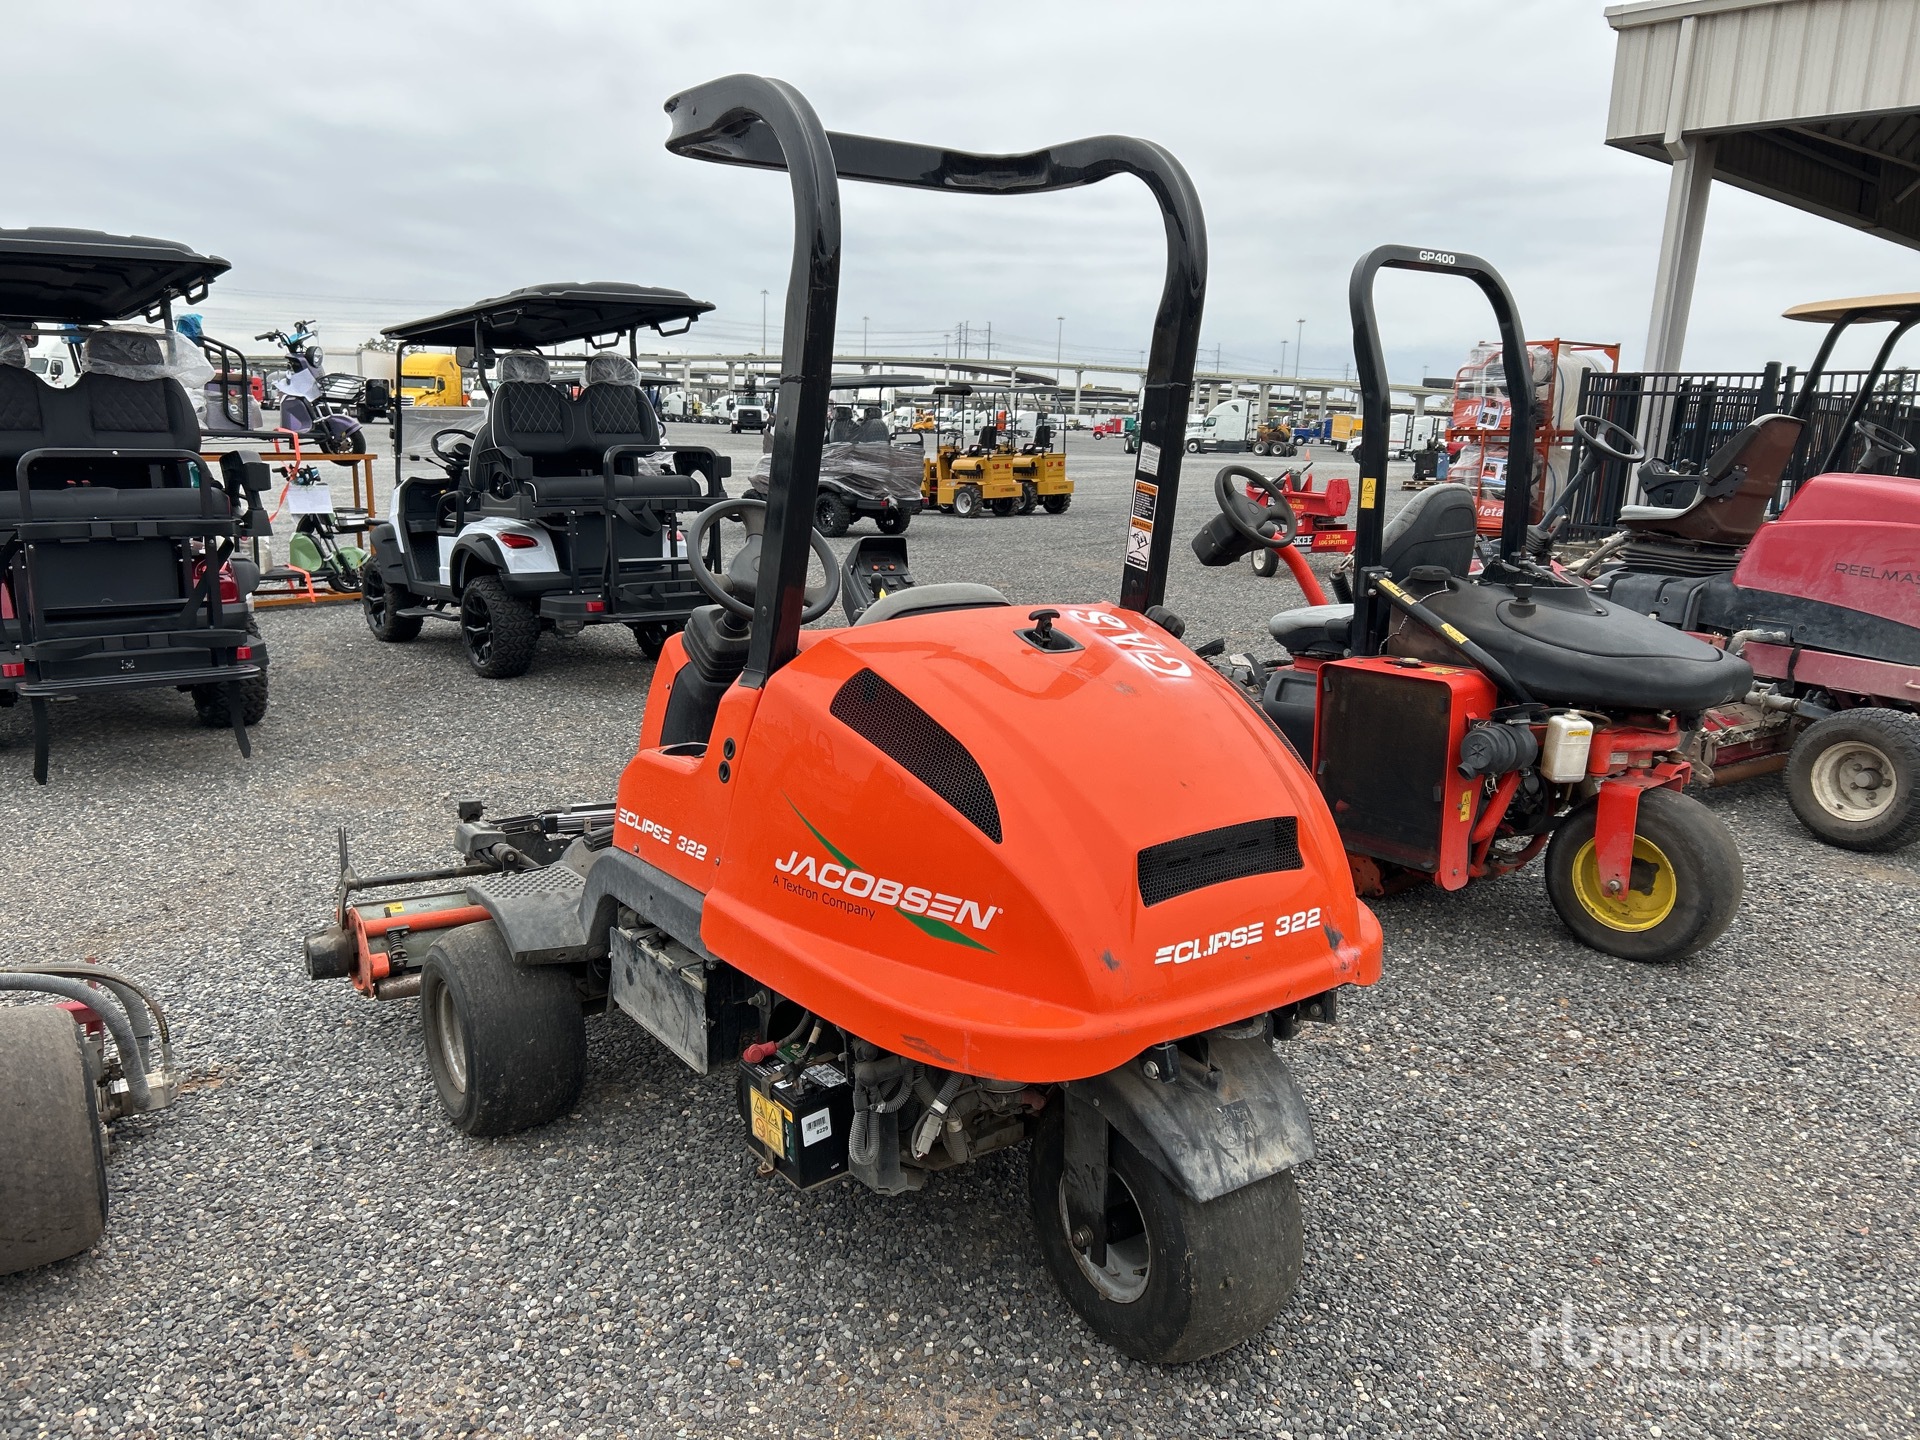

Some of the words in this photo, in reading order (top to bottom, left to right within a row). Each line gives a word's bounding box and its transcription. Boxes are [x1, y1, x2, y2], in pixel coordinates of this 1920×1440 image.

[1419, 250, 1456, 265] GP400
[1477, 505, 1504, 517] Meta
[1291, 535, 1313, 545] SKEE
[1067, 609, 1193, 678] GAS
[618, 807, 672, 845] ECLIPSE
[676, 835, 708, 862] 322
[772, 874, 780, 886] A
[782, 877, 819, 902] Textron
[821, 892, 876, 921] Company
[774, 850, 998, 931] JACOBSEN
[1154, 921, 1265, 965] ECLIPSE
[1274, 907, 1322, 937] 322
